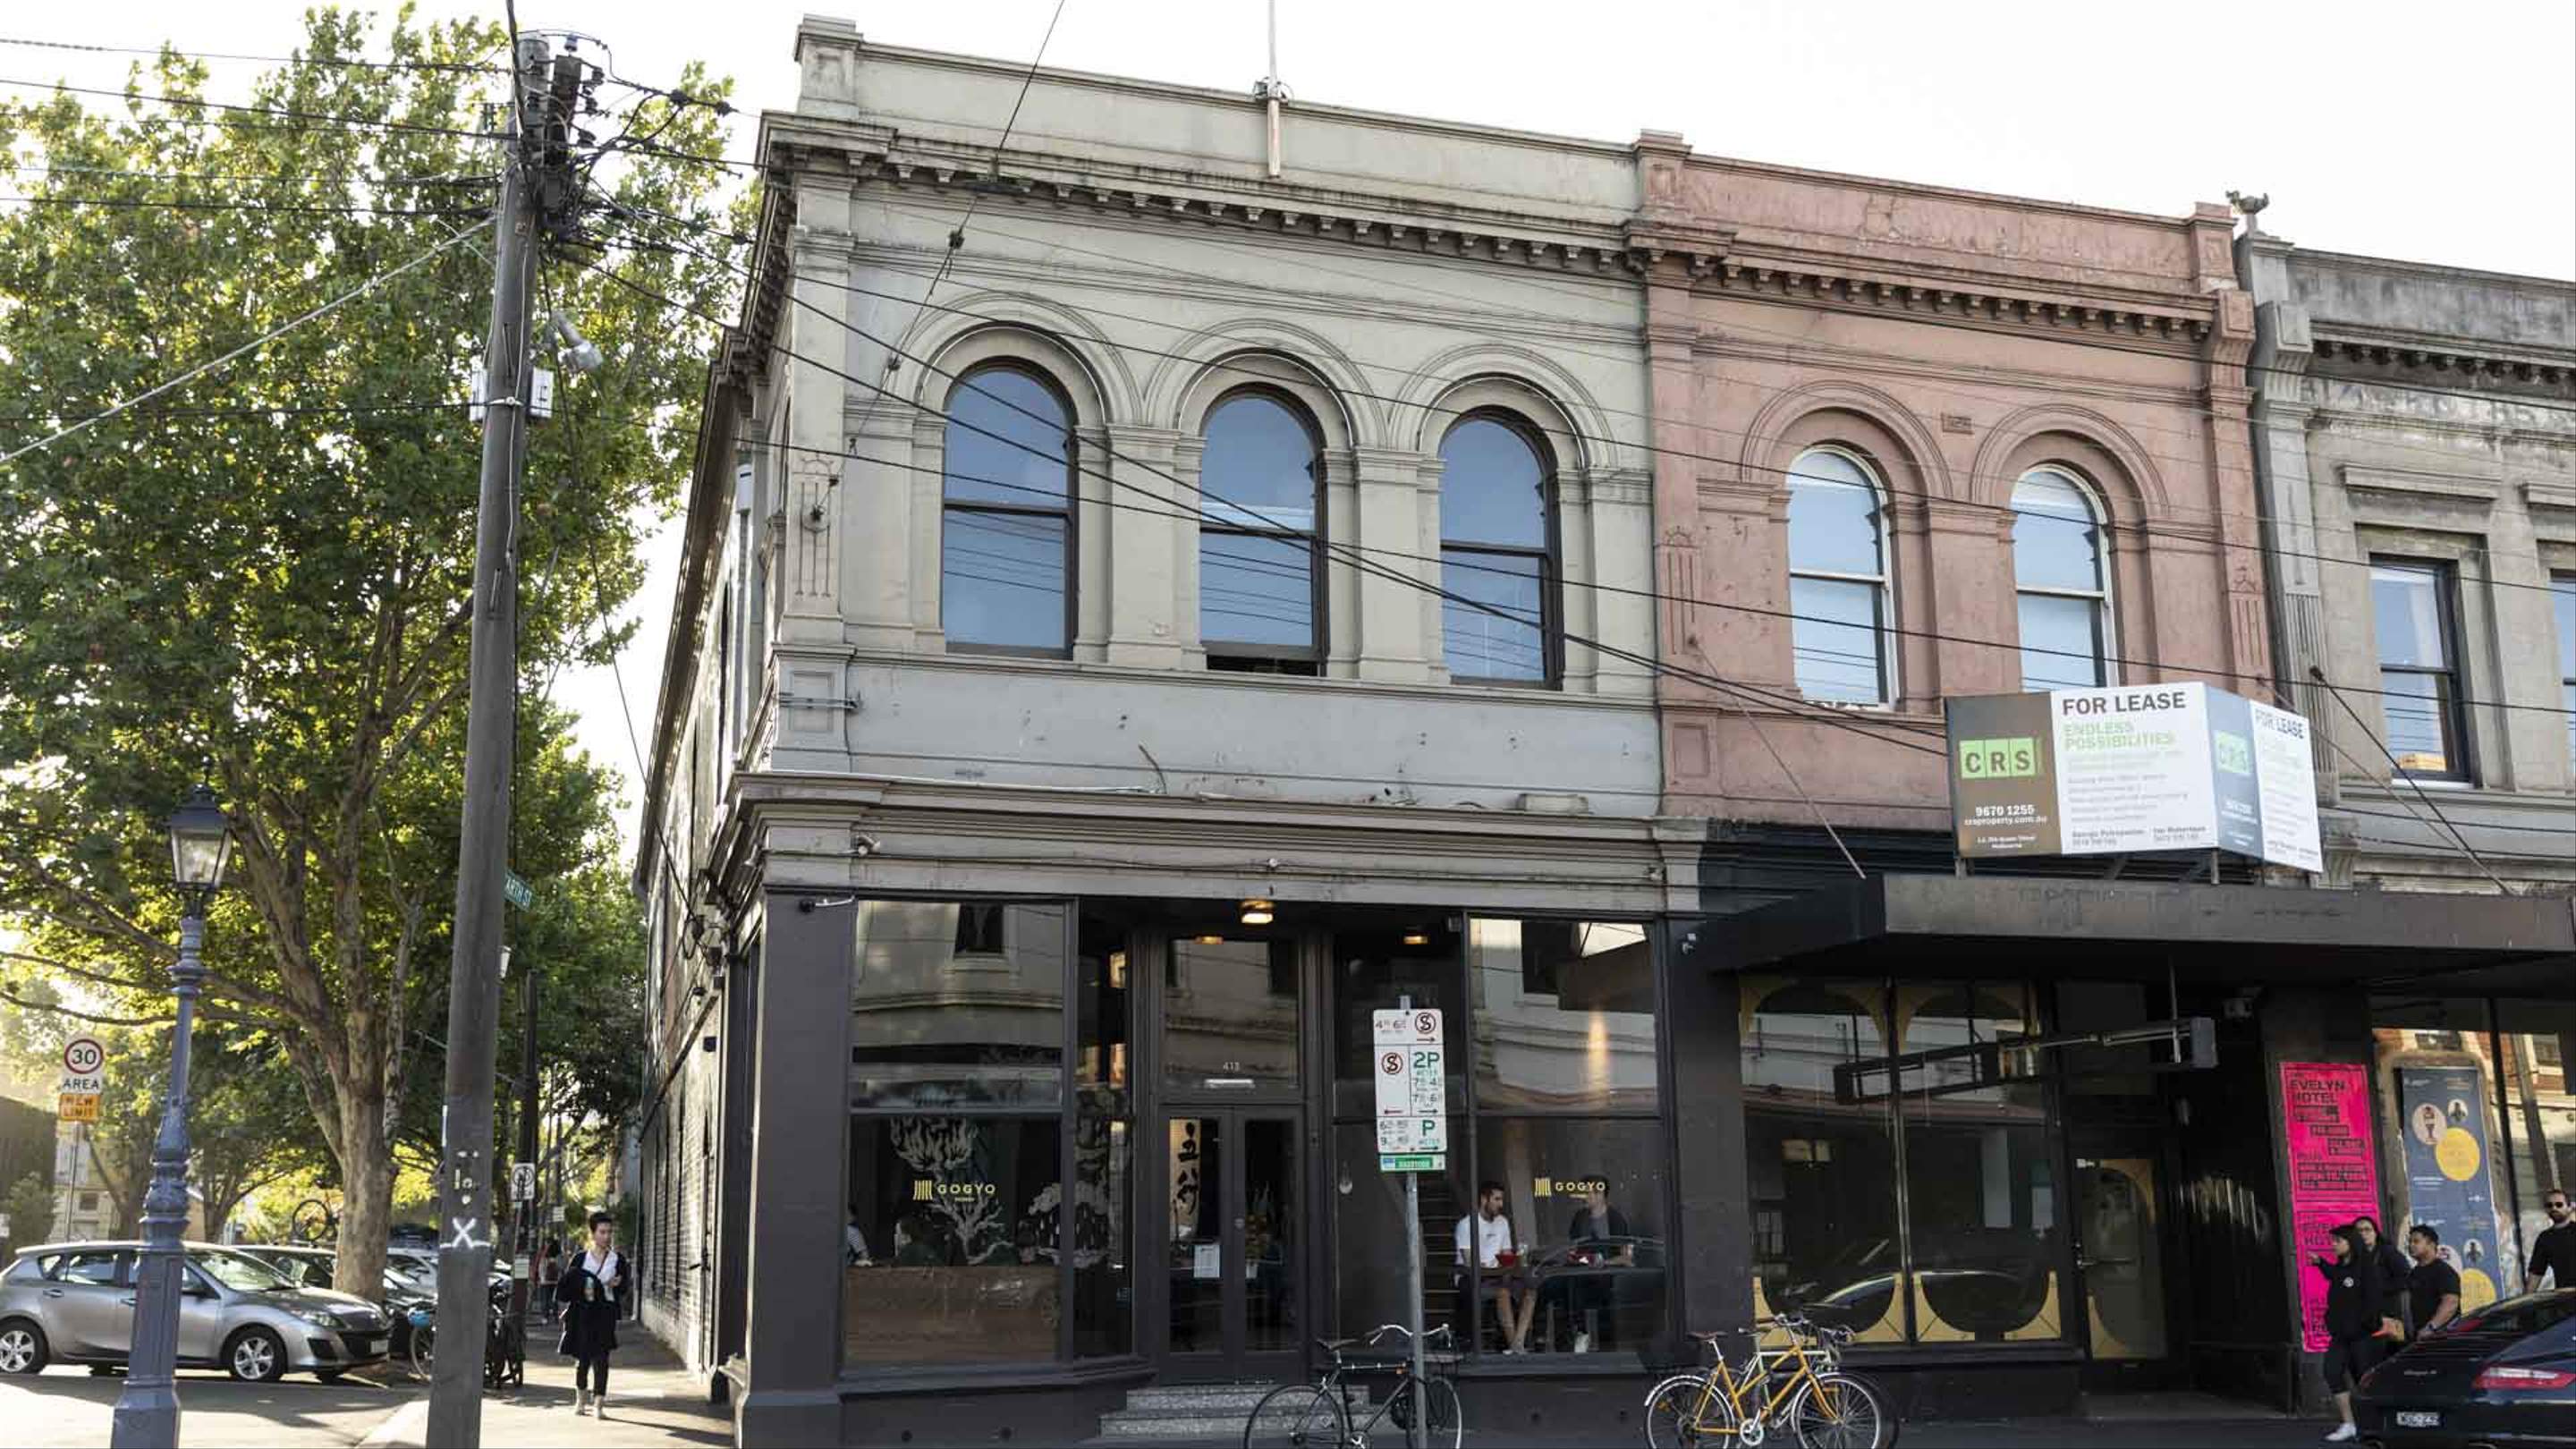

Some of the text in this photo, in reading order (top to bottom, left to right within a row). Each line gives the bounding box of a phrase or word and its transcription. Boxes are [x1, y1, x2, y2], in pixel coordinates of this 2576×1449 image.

[2063, 691, 2186, 716] FOR LEASE
[2276, 717, 2305, 741] LEASE
[1965, 750, 2031, 774] CRS
[72, 1049, 97, 1064] 30
[1413, 1052, 1440, 1068] 2P
[63, 1078, 98, 1089] AREA
[2290, 1080, 2345, 1090] EVELYN
[2294, 1092, 2338, 1102] HOTEL
[1422, 1120, 1436, 1136] P
[937, 1182, 996, 1195] GOGYO
[1555, 1181, 1606, 1192] GOGYO
